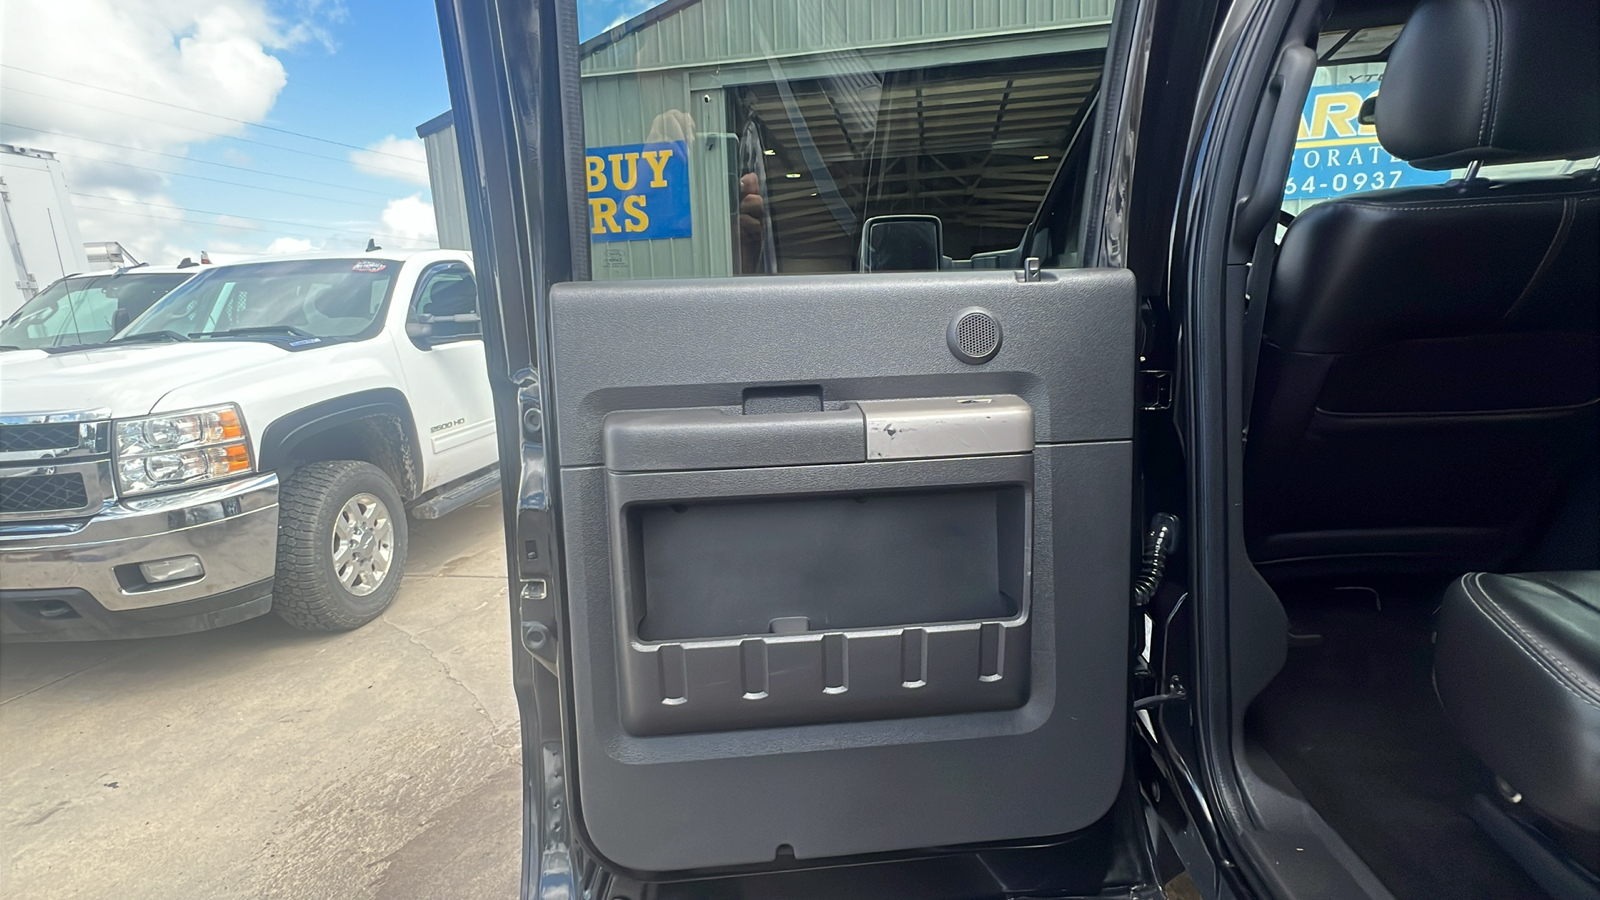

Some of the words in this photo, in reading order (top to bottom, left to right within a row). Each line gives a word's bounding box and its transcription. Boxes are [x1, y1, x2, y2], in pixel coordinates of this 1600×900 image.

[1292, 146, 1403, 168] ORAT
[585, 149, 674, 193] BUY
[1284, 170, 1403, 195] 64-0937
[588, 194, 650, 234] RS
[431, 422, 452, 433] 2500
[453, 418, 465, 426] HD
